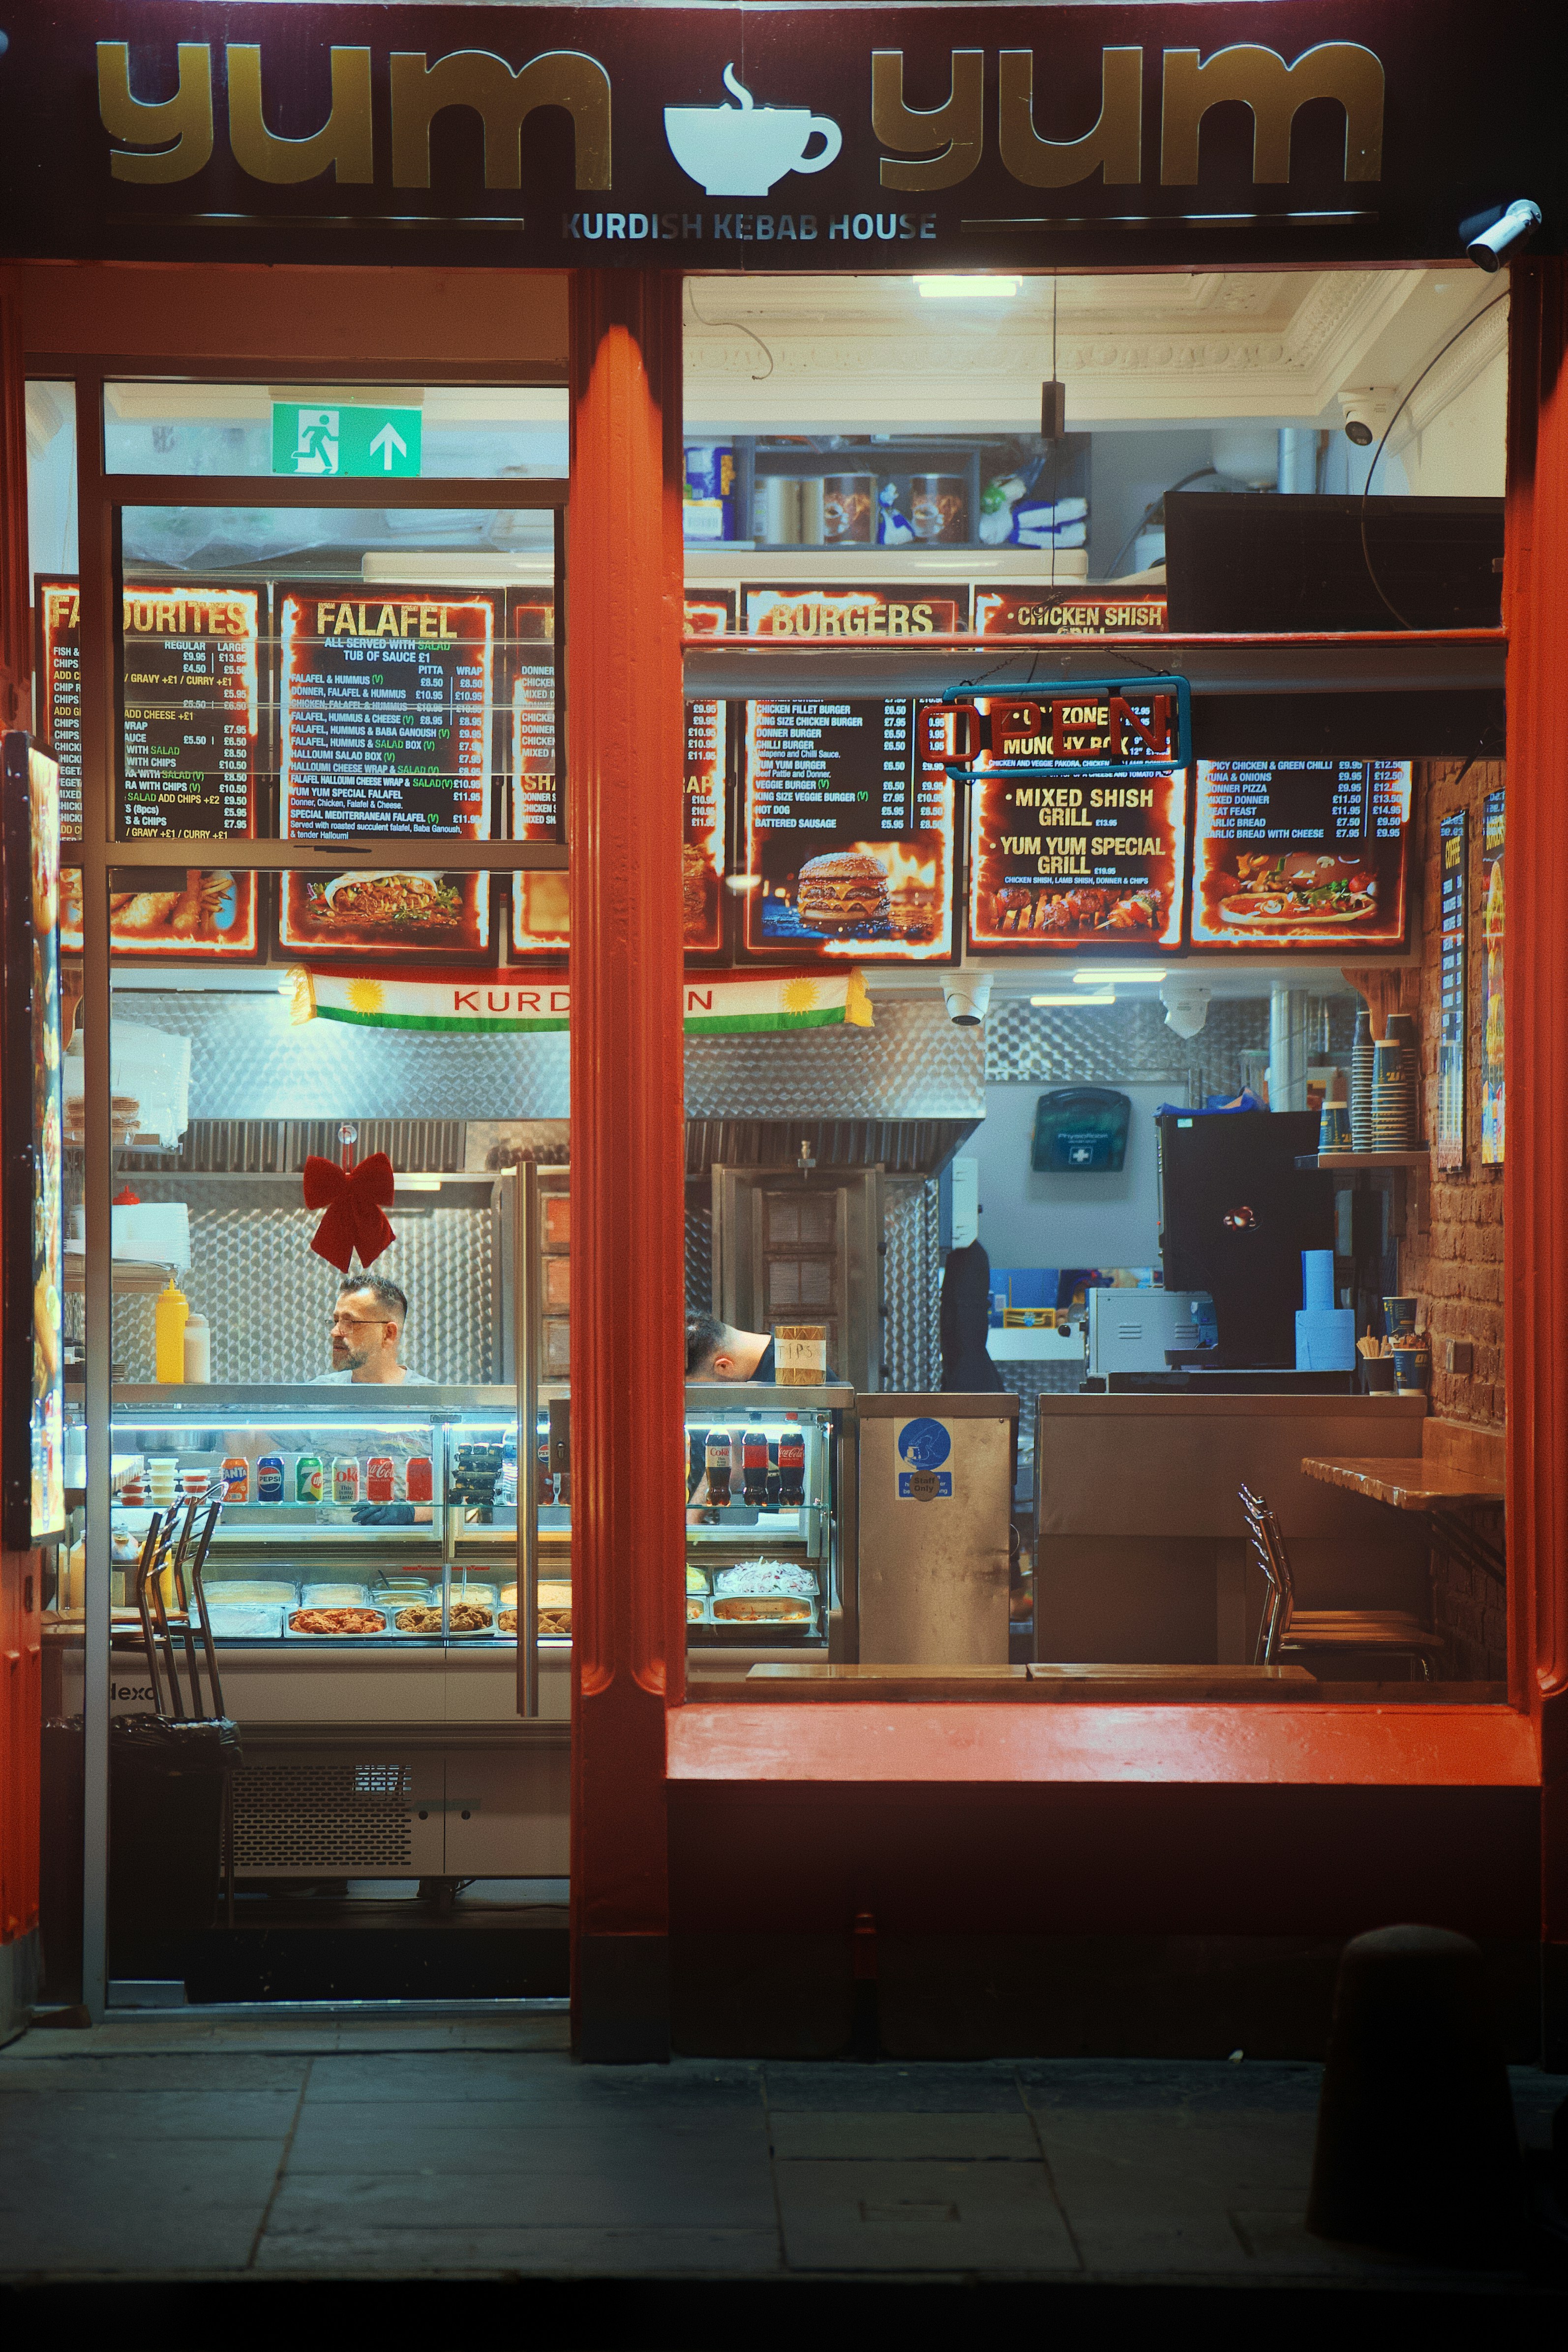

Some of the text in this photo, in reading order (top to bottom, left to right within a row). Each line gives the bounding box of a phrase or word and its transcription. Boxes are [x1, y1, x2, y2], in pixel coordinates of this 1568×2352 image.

[96, 40, 1386, 192] yum yum
[563, 213, 937, 241] KURDISH KEBAB HOUSE
[317, 602, 457, 638] FALAFEL
[772, 603, 934, 636] BURGERS
[1018, 607, 1161, 627] CHICKEN SHISH
[54, 647, 79, 656] FISH &
[164, 641, 246, 652] REGULAR LARGE
[183, 652, 206, 661] £9.95
[343, 649, 430, 663] TUB OF SAUCE £1
[54, 659, 79, 668] CHIPS
[183, 664, 206, 673] £4.50
[418, 665, 482, 676] PITTA WRAP
[521, 666, 555, 675] DONNER
[131, 674, 159, 683] GRAVY
[162, 675, 177, 684] +£1
[186, 676, 214, 685] CURRY
[216, 677, 232, 686] +£1
[291, 674, 443, 687] FALAFEL & HUMMUS (V) £8.50
[124, 709, 193, 721] ADD CHEESE +£1
[756, 704, 906, 715] CHICKEN FILLET BURGER £6.50
[329, 713, 362, 723] HUMMUS
[364, 714, 370, 723] &
[372, 714, 401, 724] CHEESE
[402, 715, 414, 725] (V)
[420, 716, 443, 725] £8.95
[756, 717, 906, 727] KING SIZE CHICKEN BURGER £7.95
[224, 725, 246, 734] £7.95
[688, 728, 716, 737] £10.95
[756, 729, 906, 739] DONNER BURGER £6.50
[919, 695, 1167, 763] OPEN
[126, 745, 246, 758] WITH SALAD £8.50
[291, 750, 395, 762] HALLOUMI SALAD BOX (V)
[126, 758, 247, 769] WITH CHIPS £10.50
[1232, 761, 1332, 770] CHICKEN & GREEN CHILLI
[1206, 772, 1362, 782] TUNA & ONIONS £9.95
[755, 779, 905, 791] VEGGIE BURGER (V) £6.50
[291, 797, 316, 807] Donner,
[317, 798, 345, 808] Chicken,
[347, 799, 368, 808] Falafel
[377, 800, 403, 809] Cheese.
[1016, 789, 1153, 807] MIXED SHISH
[291, 809, 439, 824] SPECIAL MEDITERRANEAN FALAFEL (V)
[755, 805, 905, 816] HOT DOG £5.95
[1230, 805, 1401, 816] FEAST £11.95 £14.95
[1039, 808, 1092, 826] GRILL
[291, 820, 314, 828] Served
[315, 821, 329, 829] with
[357, 823, 388, 831] succulent
[390, 824, 412, 832] falafel,
[431, 825, 462, 834] Ganoush,
[755, 819, 904, 829] BATTERED SAUSAGE £5.95
[1236, 828, 1400, 838] BREAD WITH CHEESE £7.95 £9.95
[1000, 836, 1166, 855] YUM YUM SPECIAL
[1446, 836, 1460, 870] COFFEE
[1037, 856, 1091, 874] GRILL
[778, 1343, 812, 1359] TIPS
[710, 1448, 729, 1456] Coke
